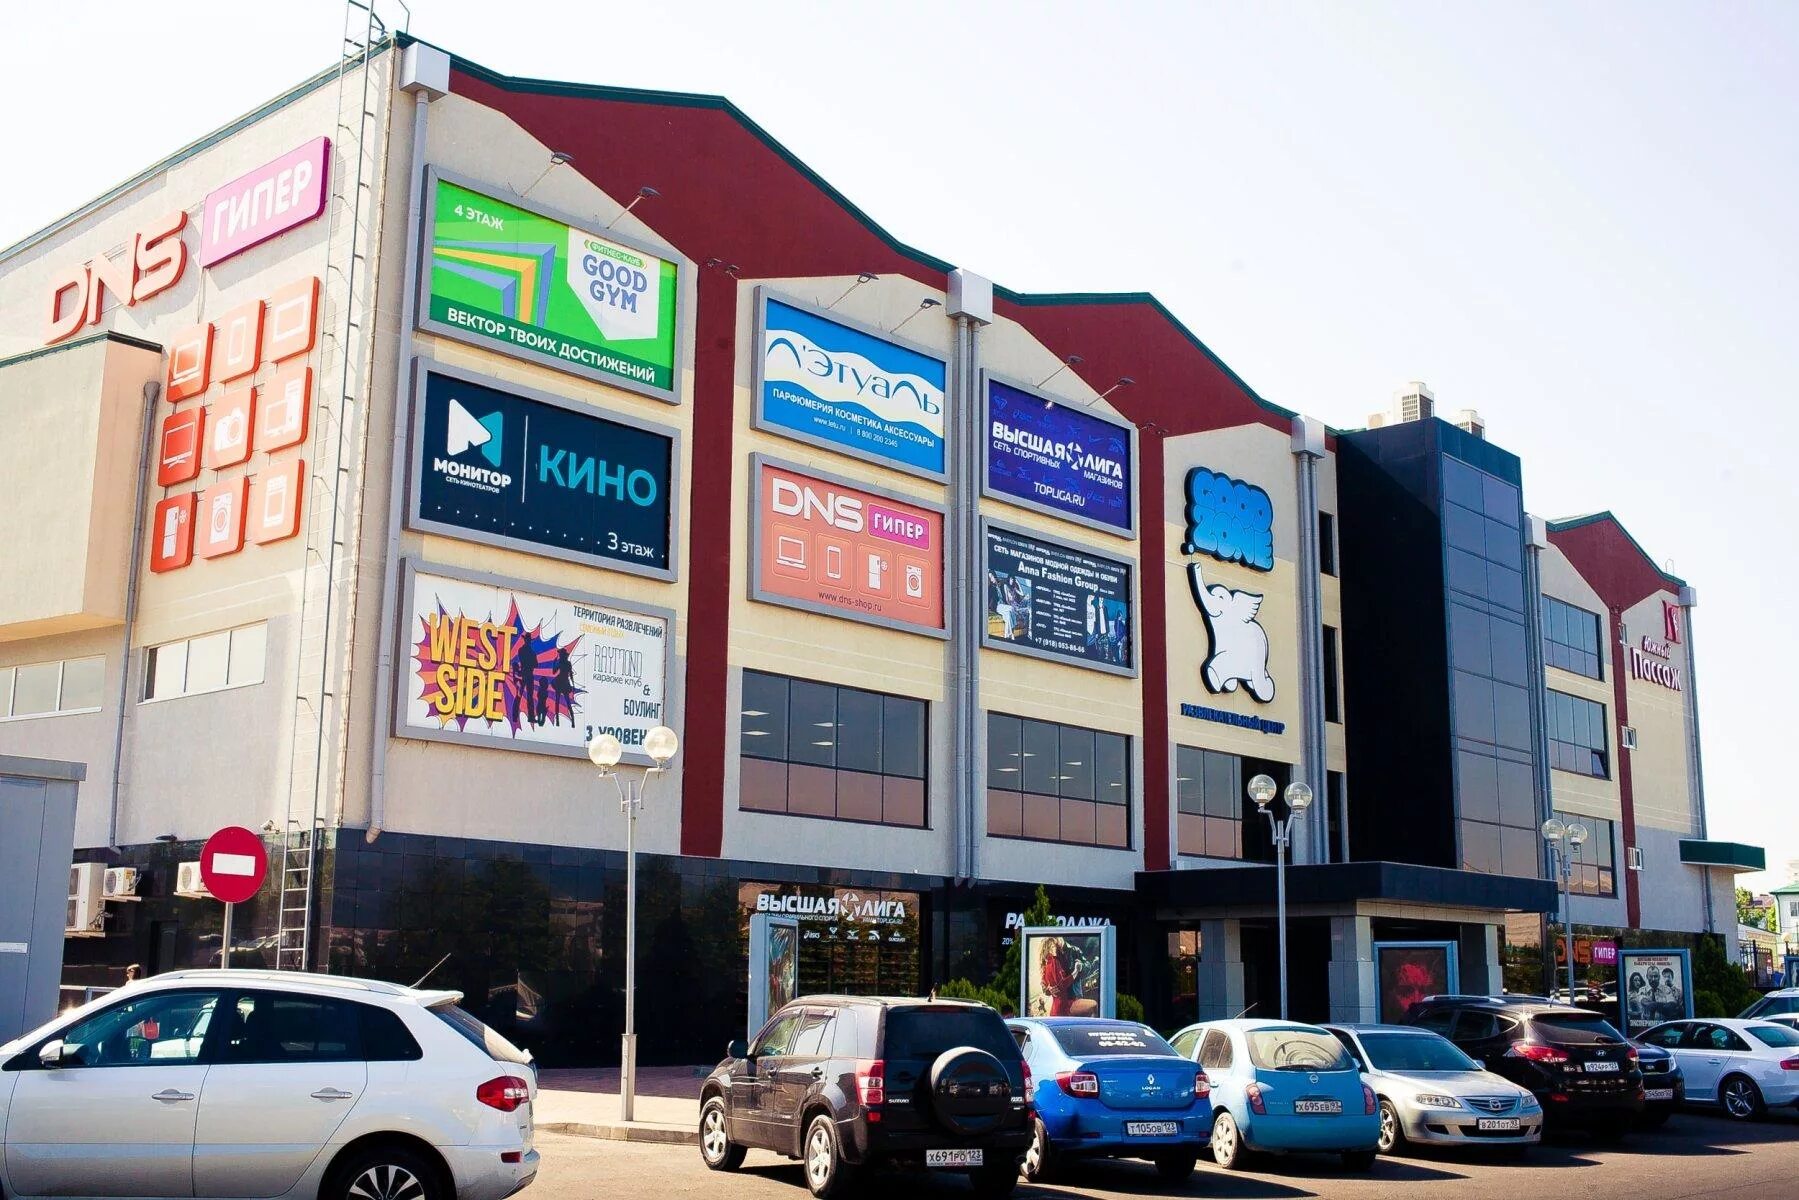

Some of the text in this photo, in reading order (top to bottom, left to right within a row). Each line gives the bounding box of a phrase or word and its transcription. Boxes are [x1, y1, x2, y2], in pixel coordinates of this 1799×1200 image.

[212, 159, 313, 245] ГИПЕР
[454, 204, 504, 231] 4 ЭТАЖ
[46, 210, 188, 345] DNS
[582, 254, 648, 293] GOOD
[590, 281, 637, 313] GYM
[448, 307, 655, 383] ВЕКТОР ТВОИХ ДОСТИЖЕНИЙ
[773, 388, 935, 448] ПАРФЮМЕРИЯ КОСМЕТИКА АКСЕССУАРЫ
[992, 421, 1123, 479] ВЫСШАЯ ЛИГА
[993, 440, 1123, 490] СЕТЬ СПОРТИВНЫХ МАГАЗИНОВ
[433, 457, 512, 488] МОНИТОР
[539, 445, 657, 507] КИНО
[772, 477, 864, 533] DNS
[1033, 481, 1086, 507] TOPLIGA.RU
[873, 512, 924, 541] ГИПЕР
[607, 532, 654, 559] 3 этаж
[1018, 560, 1040, 577] Anna
[1041, 566, 1073, 585] Fashion
[1074, 576, 1098, 593] Group
[818, 591, 882, 612] www.dns-shop.ru
[573, 605, 615, 626] ТЕРРИТОРИЯ
[616, 617, 663, 639] РАЗВЛЕЧЕНИЙ
[429, 613, 517, 673] WEST
[592, 673, 642, 688] караоке клуб
[1630, 647, 1682, 691] Пассаж
[435, 663, 505, 721] SIDE
[642, 684, 651, 696] &
[623, 699, 661, 720] БОУЛИНГ
[756, 893, 906, 918] ВЫСШАЯ ЛИГА
